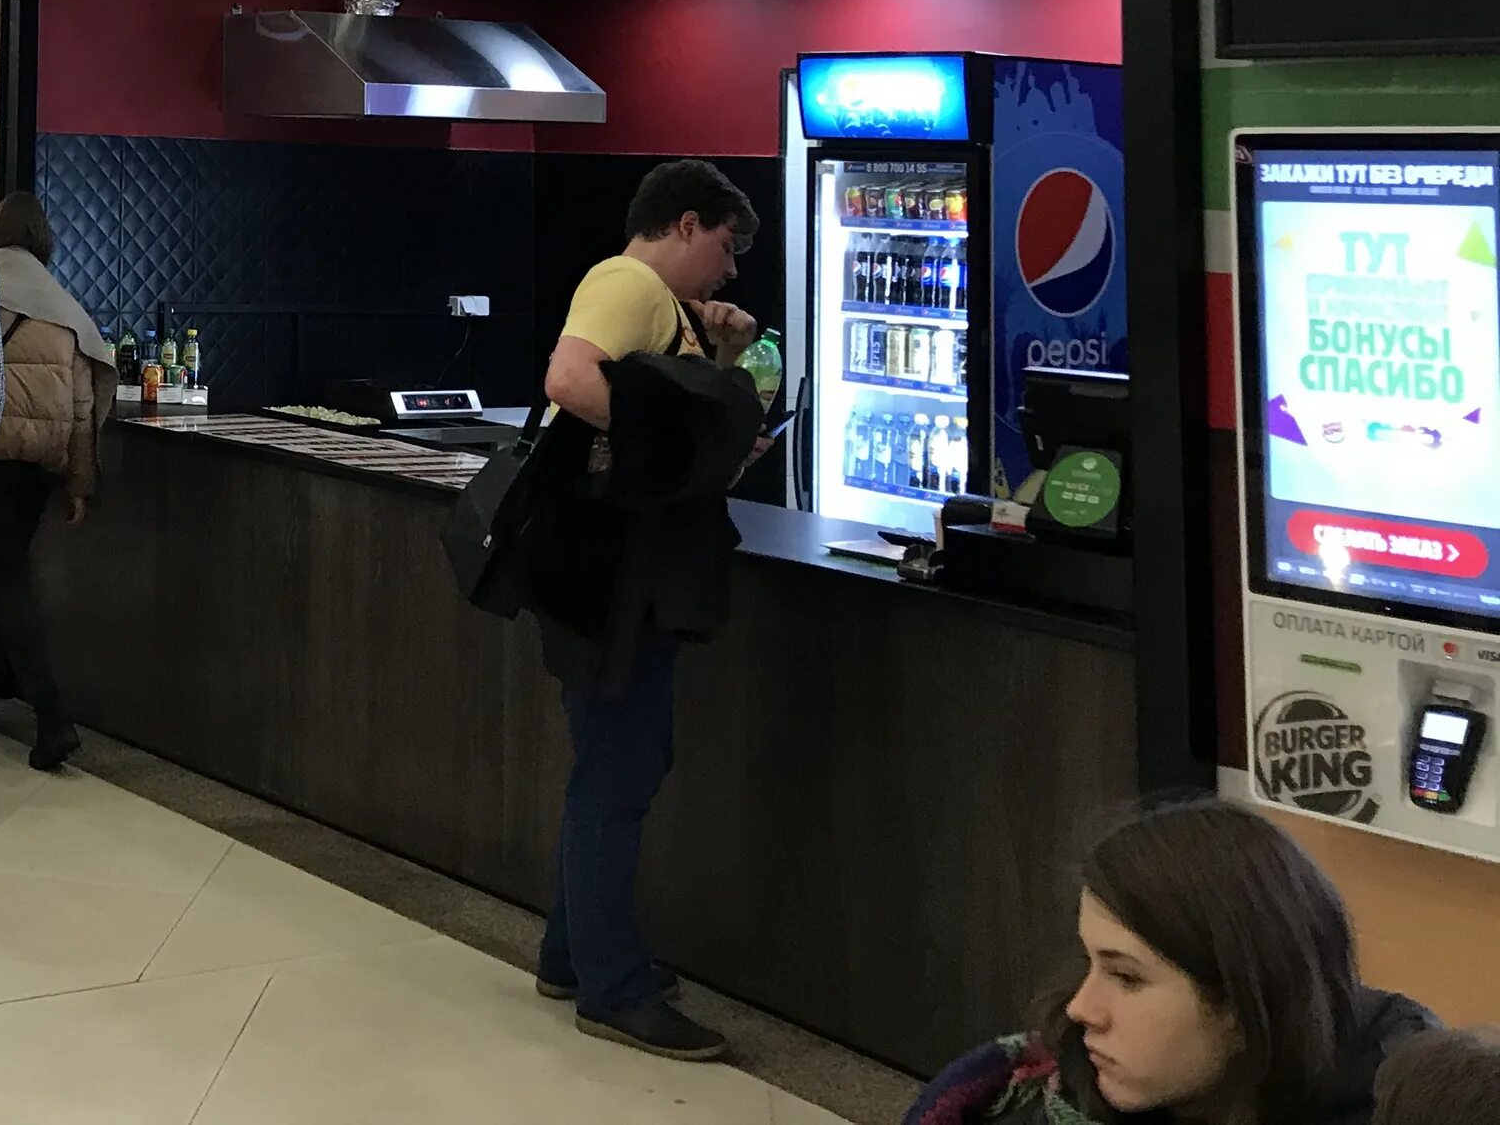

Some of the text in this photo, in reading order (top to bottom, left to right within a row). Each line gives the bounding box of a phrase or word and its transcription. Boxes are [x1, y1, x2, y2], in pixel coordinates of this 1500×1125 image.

[1260, 164, 1494, 187] ЗАКАЖИ ТУТ БЕЗ ОЧЕРЕДИ
[1340, 231, 1410, 274] ТУТ
[1027, 331, 1109, 369] pepsi
[1308, 319, 1450, 361] БОНУСЫ
[1300, 355, 1464, 403] СПАСИБО
[1273, 612, 1425, 653] ОПЛАТА КАРТОЙ
[1265, 725, 1367, 757] BURGER
[1270, 750, 1372, 794] KING
